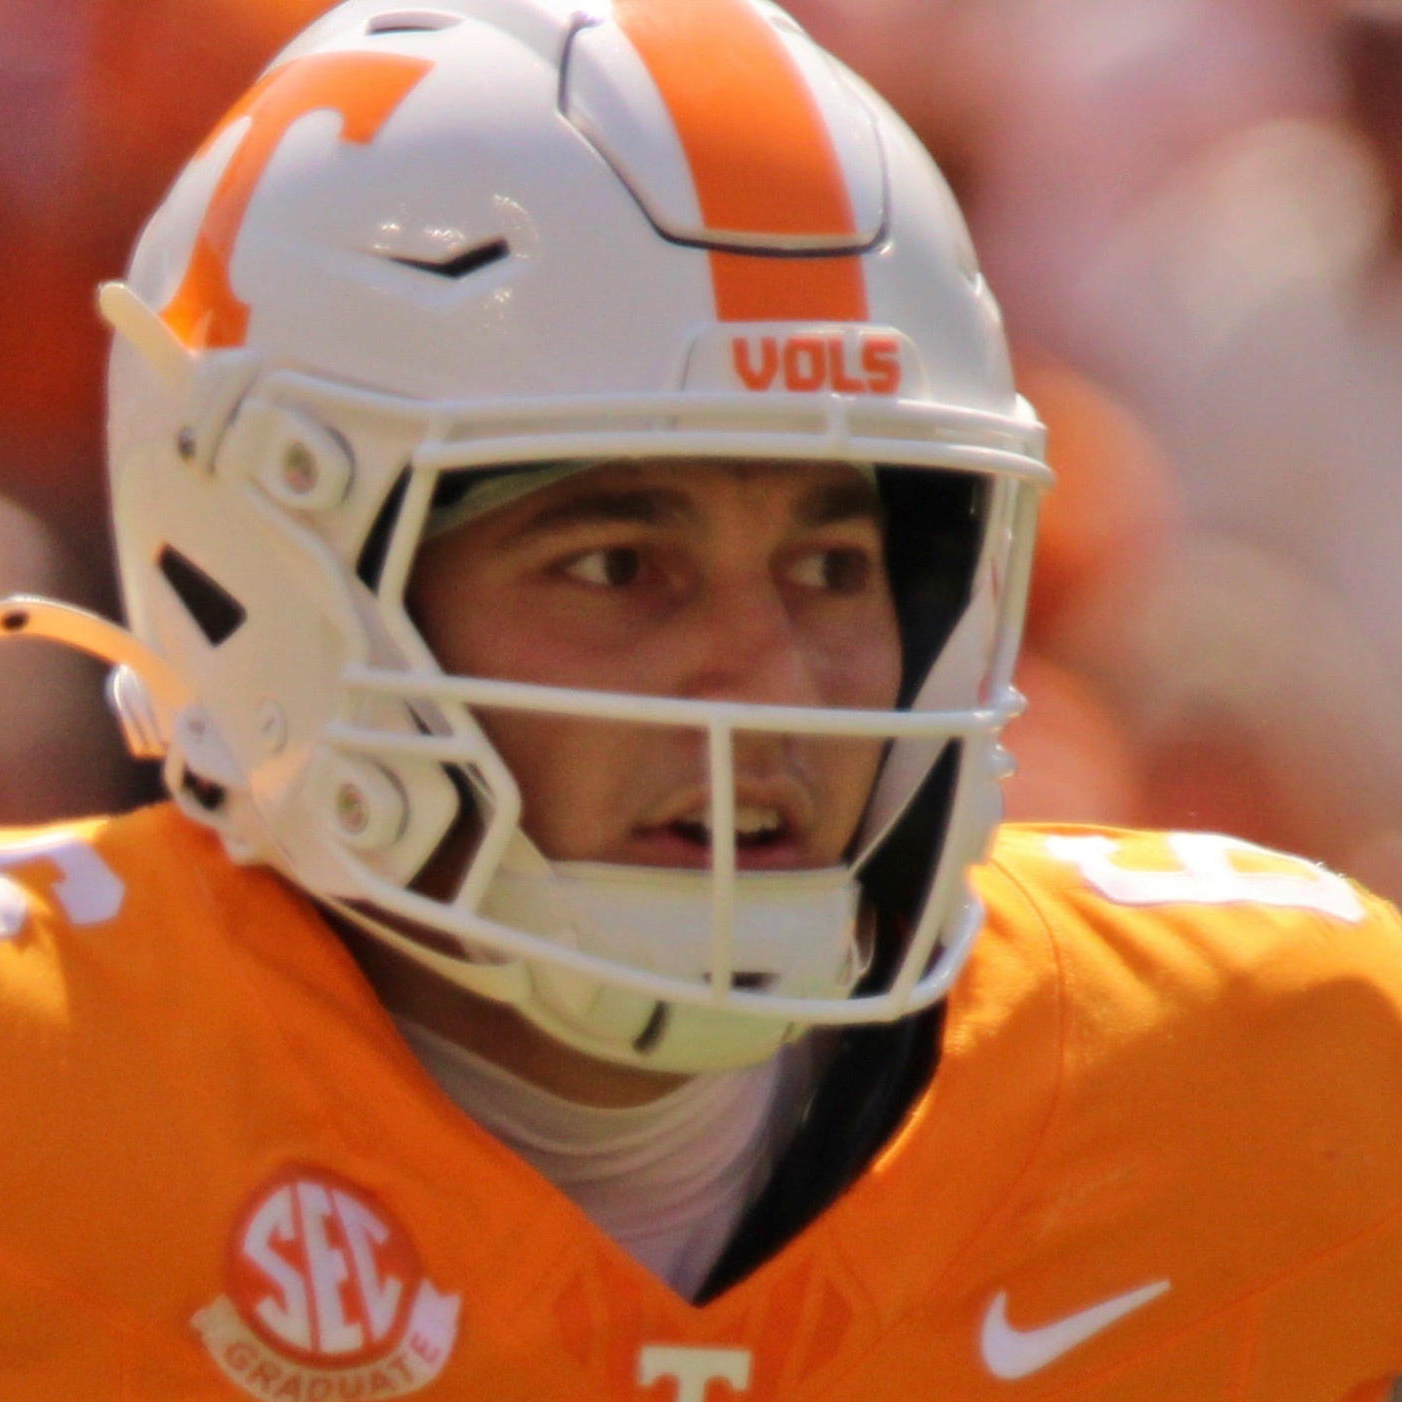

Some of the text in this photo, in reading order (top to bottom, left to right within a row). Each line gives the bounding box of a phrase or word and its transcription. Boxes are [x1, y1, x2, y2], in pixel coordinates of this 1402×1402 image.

[732, 335, 902, 395] VOLS
[243, 1180, 403, 1352] SEC
[224, 1330, 440, 1402] GRADUATE
